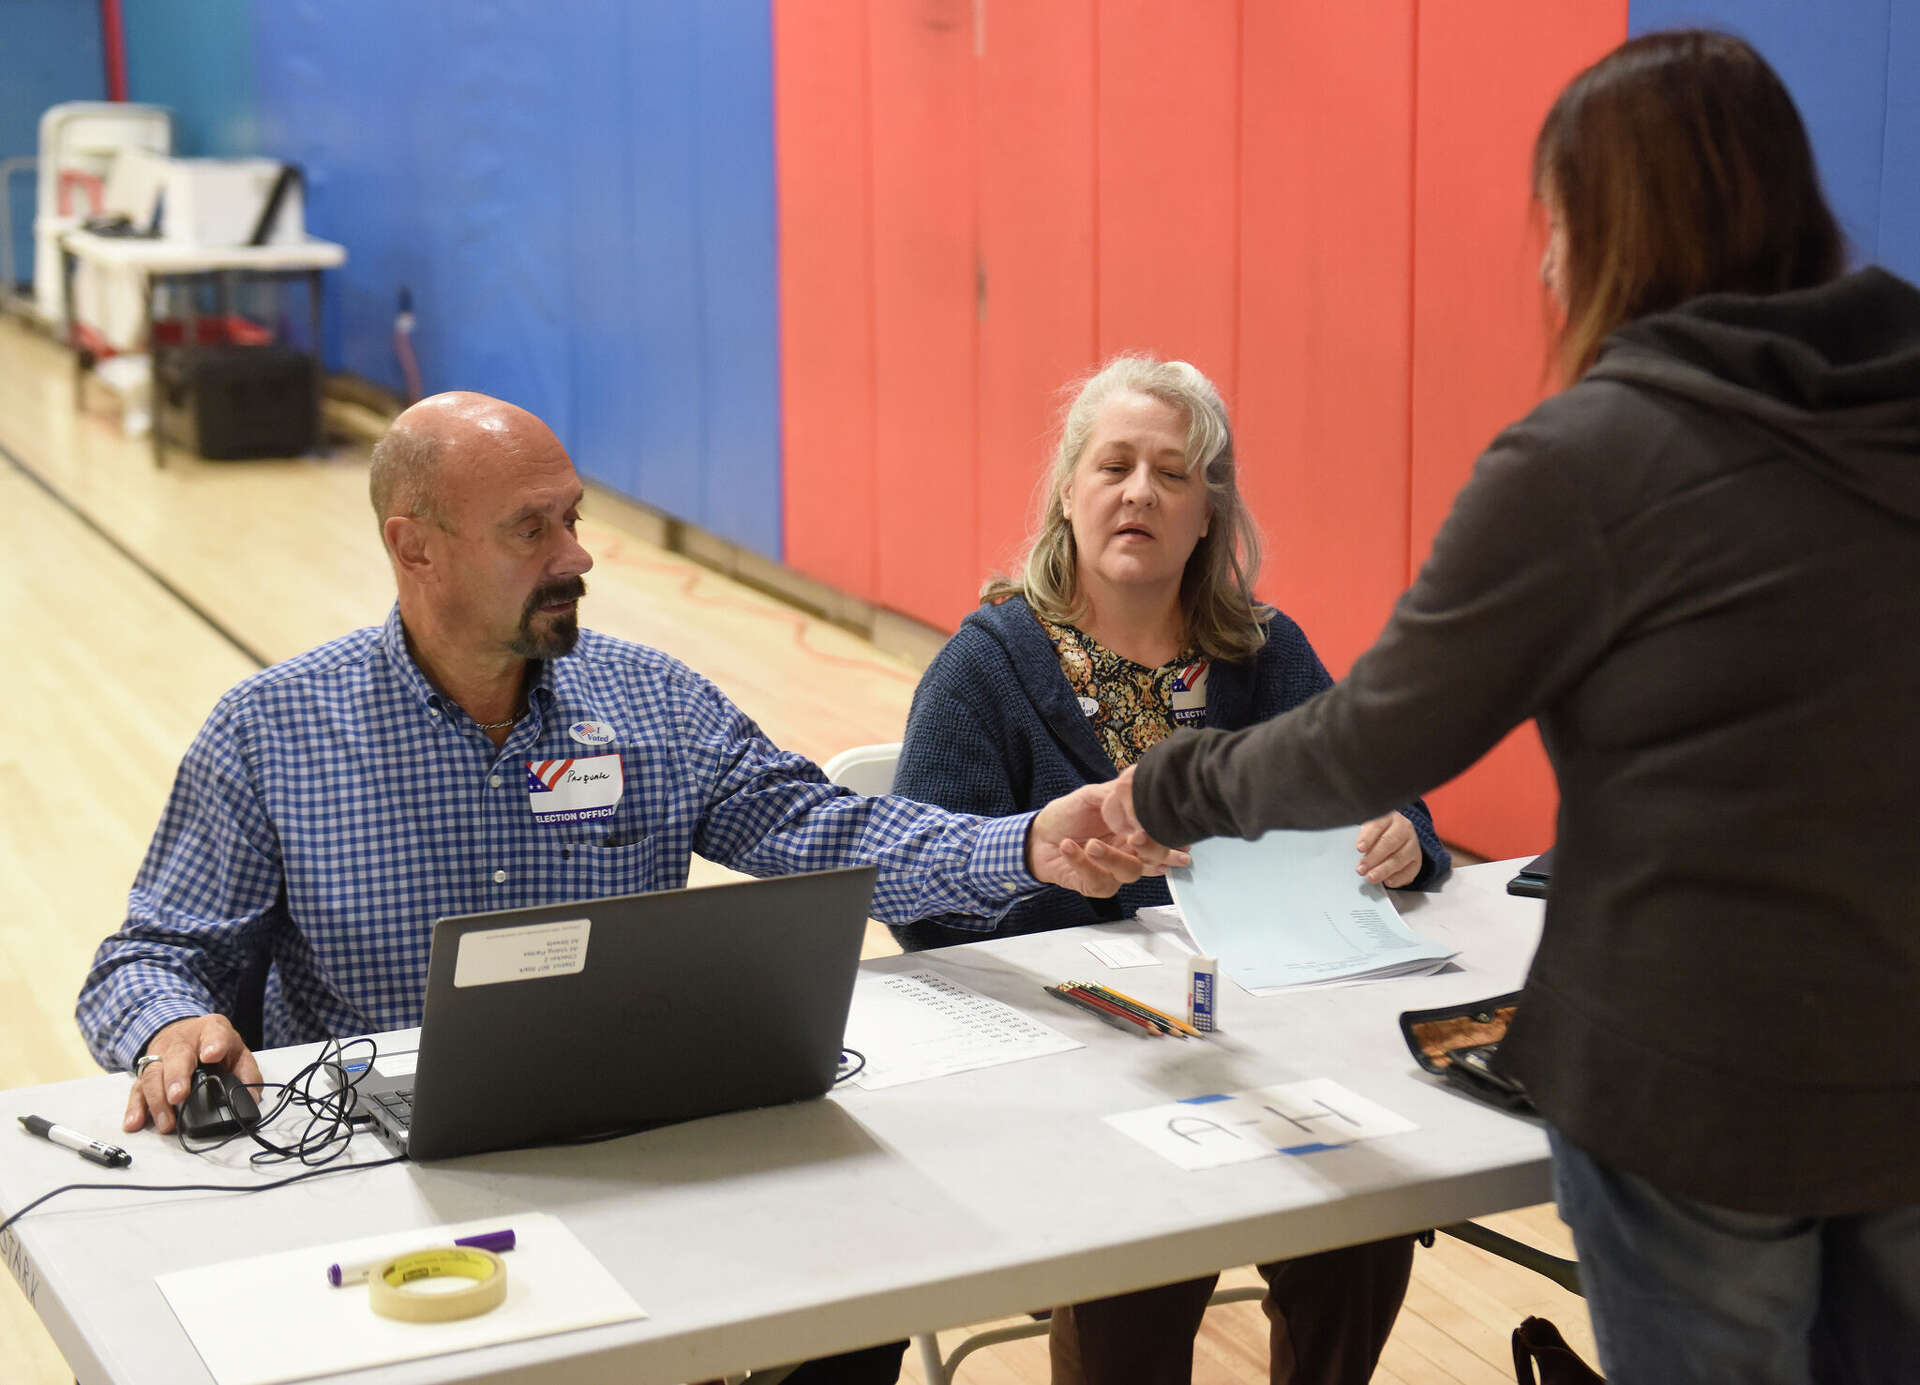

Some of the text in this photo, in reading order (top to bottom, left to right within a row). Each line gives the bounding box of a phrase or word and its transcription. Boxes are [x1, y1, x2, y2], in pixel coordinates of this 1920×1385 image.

[587, 734, 609, 743] Voted
[566, 769, 610, 784] Pasquale
[535, 813, 578, 823] ELECTION
